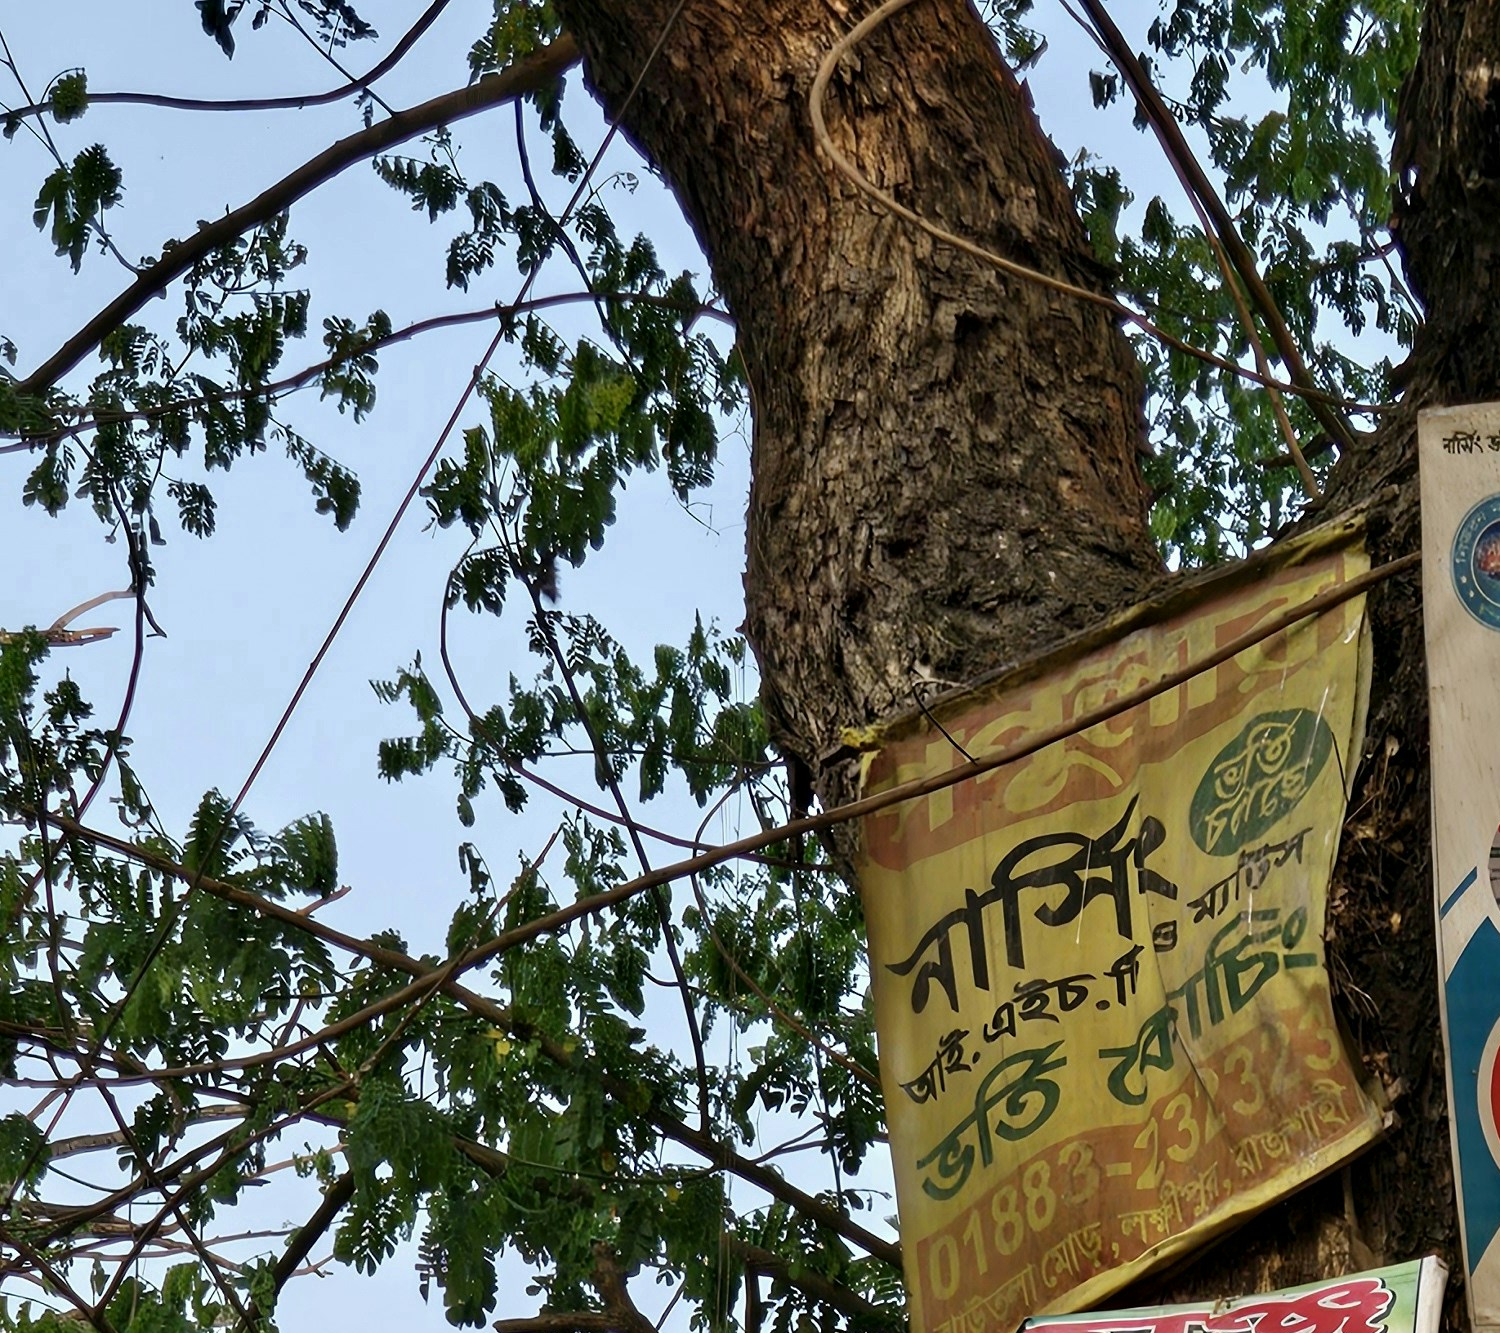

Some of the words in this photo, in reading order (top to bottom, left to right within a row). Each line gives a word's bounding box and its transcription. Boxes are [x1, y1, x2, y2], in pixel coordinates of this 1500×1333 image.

[885, 793, 1178, 1014] নার্সিং
[917, 1040, 1067, 1201] ভর্তি
[1099, 906, 1318, 1106] কোচিং
